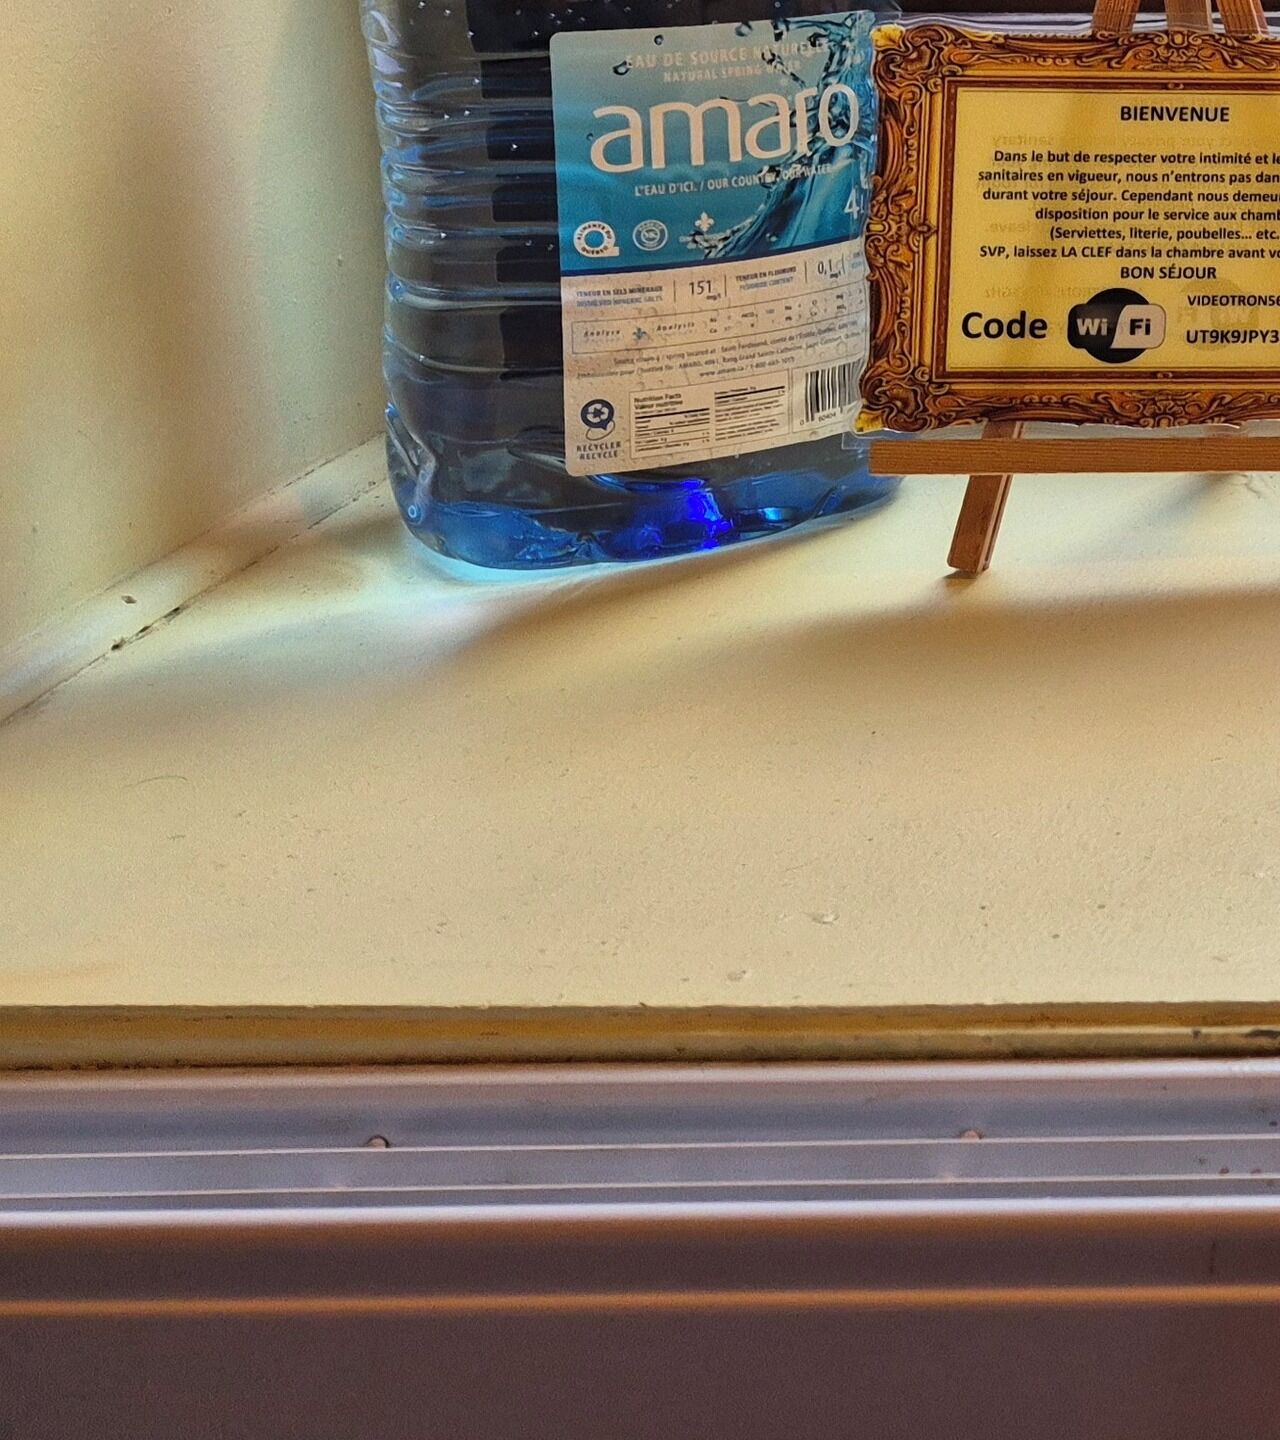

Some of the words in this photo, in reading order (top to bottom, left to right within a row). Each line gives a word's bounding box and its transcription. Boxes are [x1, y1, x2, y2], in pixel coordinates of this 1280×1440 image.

[663, 51, 684, 67] DE
[690, 47, 747, 65] SOURCE
[1120, 105, 1230, 123] BIENVENUE
[590, 83, 859, 173] amaro
[993, 149, 1028, 163] Dans
[1030, 149, 1044, 163] le
[1047, 150, 1071, 163] but
[1073, 150, 1091, 163] de
[1093, 152, 1158, 166] respecter
[1160, 152, 1196, 165] votre
[1199, 151, 1252, 165] intimité
[1254, 153, 1269, 165] et
[708, 176, 729, 190] OUR
[977, 167, 1044, 182] sanitaires
[1046, 171, 1064, 182] en
[1067, 169, 1122, 185] vigueur,
[1125, 172, 1159, 183] nous
[1228, 173, 1252, 186] pas
[982, 186, 1029, 201] durant
[1031, 189, 1068, 201] votre
[1071, 188, 1118, 204] séjour.
[1121, 189, 1194, 205] Cependant
[1197, 192, 1230, 202] nous
[1034, 207, 1109, 223] disposition
[1112, 210, 1145, 223] pour
[1147, 207, 1160, 221] le
[1163, 207, 1210, 221] service
[1213, 211, 1237, 221] aux
[1049, 225, 1126, 242] (Serviettes,
[1129, 226, 1173, 242] literie,
[979, 244, 1010, 260] SVP,
[1013, 244, 1058, 258] laissez
[1061, 245, 1078, 258] LA
[1081, 245, 1113, 258] CLEF
[1115, 245, 1147, 259] dans
[1150, 245, 1163, 258] la
[1165, 245, 1225, 259] chambre
[1227, 247, 1266, 259] avant
[1120, 265, 1155, 280] BON
[1158, 262, 1217, 280] SÉJOUR
[688, 279, 713, 296] 151
[961, 310, 1048, 339] Code
[1076, 317, 1108, 336] Wi
[1129, 318, 1151, 336] Fi
